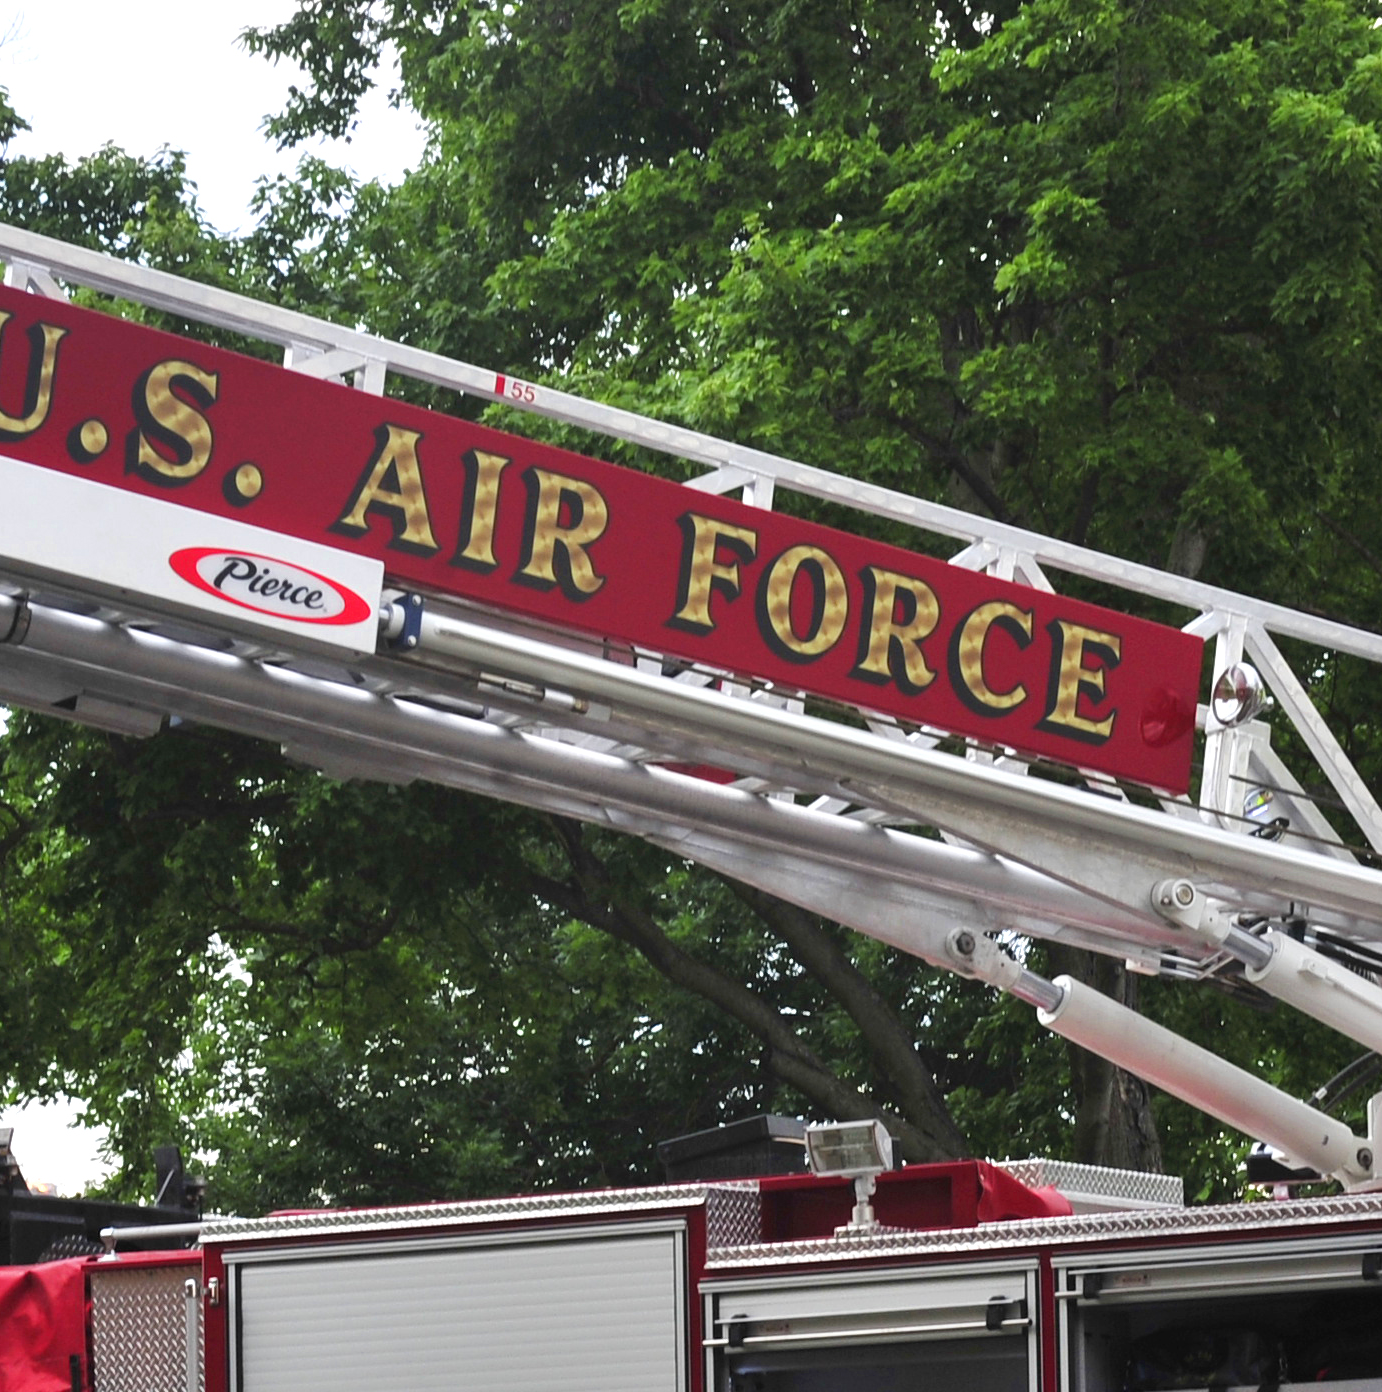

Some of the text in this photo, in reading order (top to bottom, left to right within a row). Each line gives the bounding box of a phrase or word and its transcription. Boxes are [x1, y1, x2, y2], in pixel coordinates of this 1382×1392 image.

[510, 381, 536, 403] 55
[213, 556, 325, 610] Pierce
[327, 420, 610, 603] AIR
[664, 511, 1122, 747] FORCE
